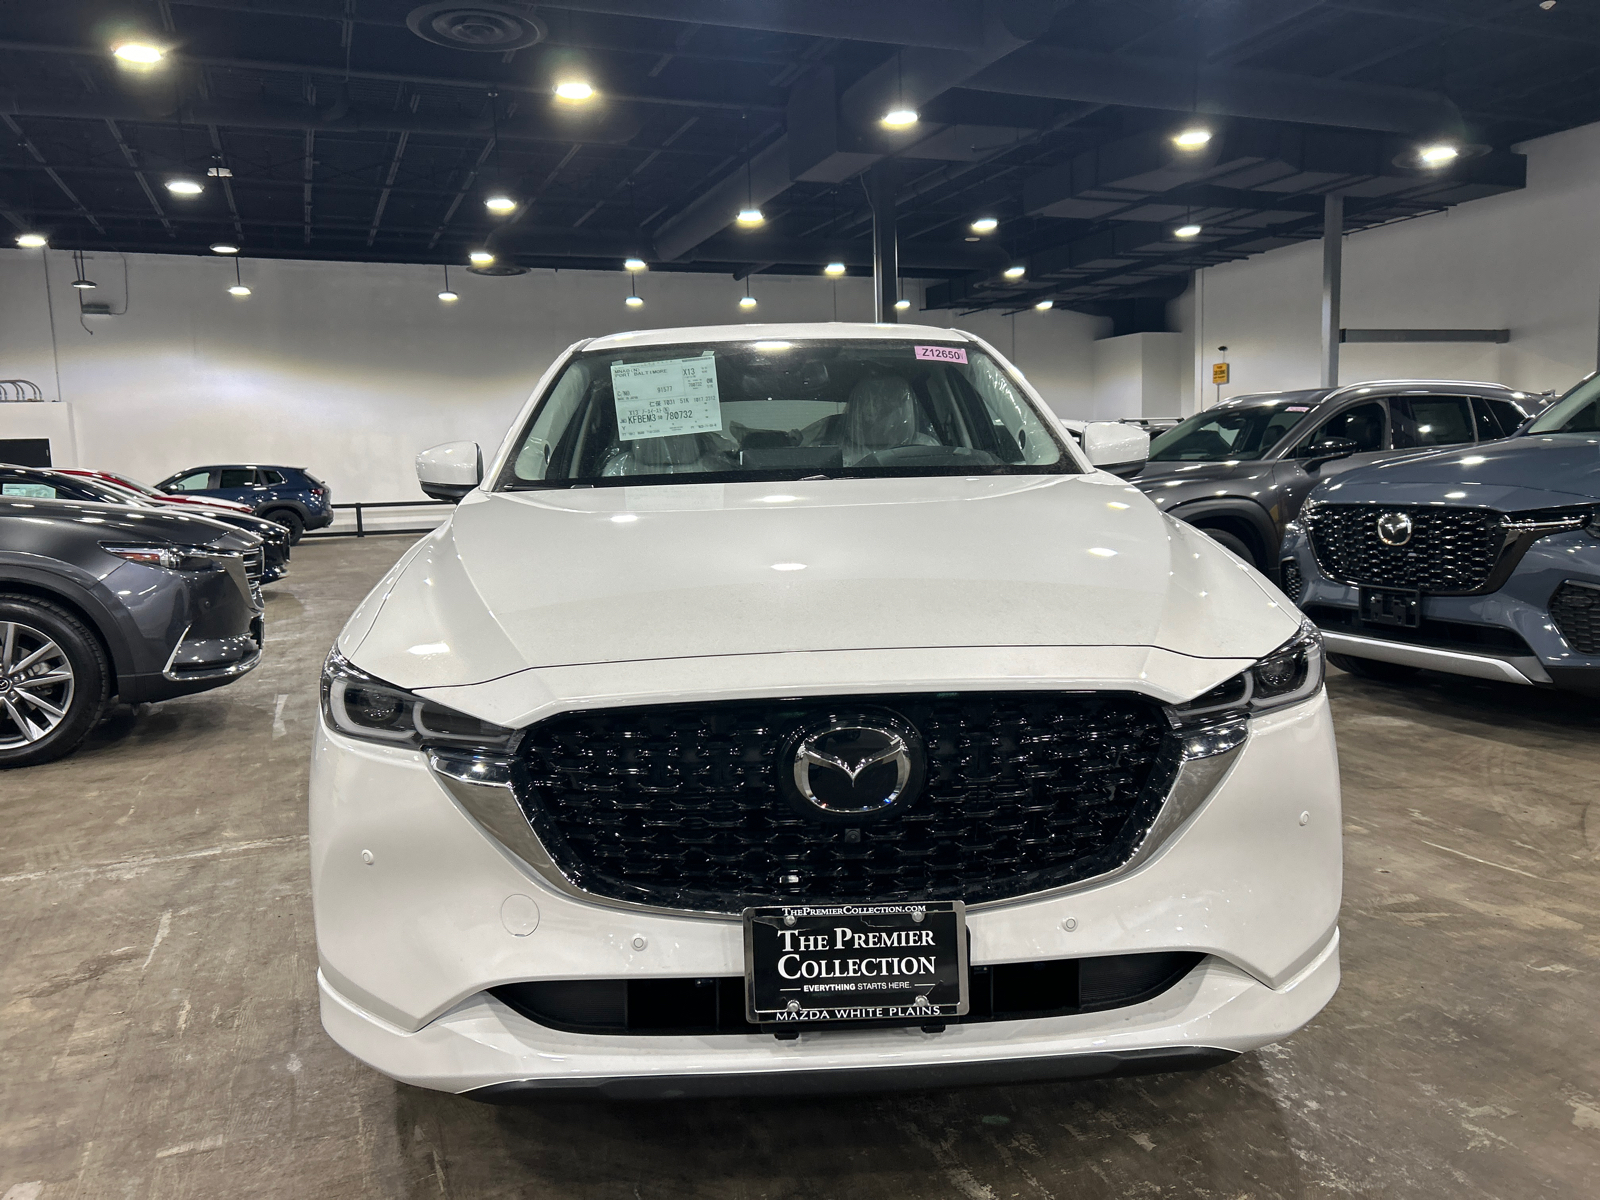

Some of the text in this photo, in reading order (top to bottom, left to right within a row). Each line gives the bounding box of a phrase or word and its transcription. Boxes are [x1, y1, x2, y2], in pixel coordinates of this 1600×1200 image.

[922, 348, 960, 360] Z12650
[682, 368, 696, 376] X13
[628, 414, 656, 424] KFBEM3
[666, 410, 693, 420] 780732
[834, 928, 936, 950] PREMIER
[778, 954, 936, 979] COLLECTION
[804, 984, 856, 992] EVERYTHING
[776, 1006, 940, 1021] MAZDA WHITE PLAINS
